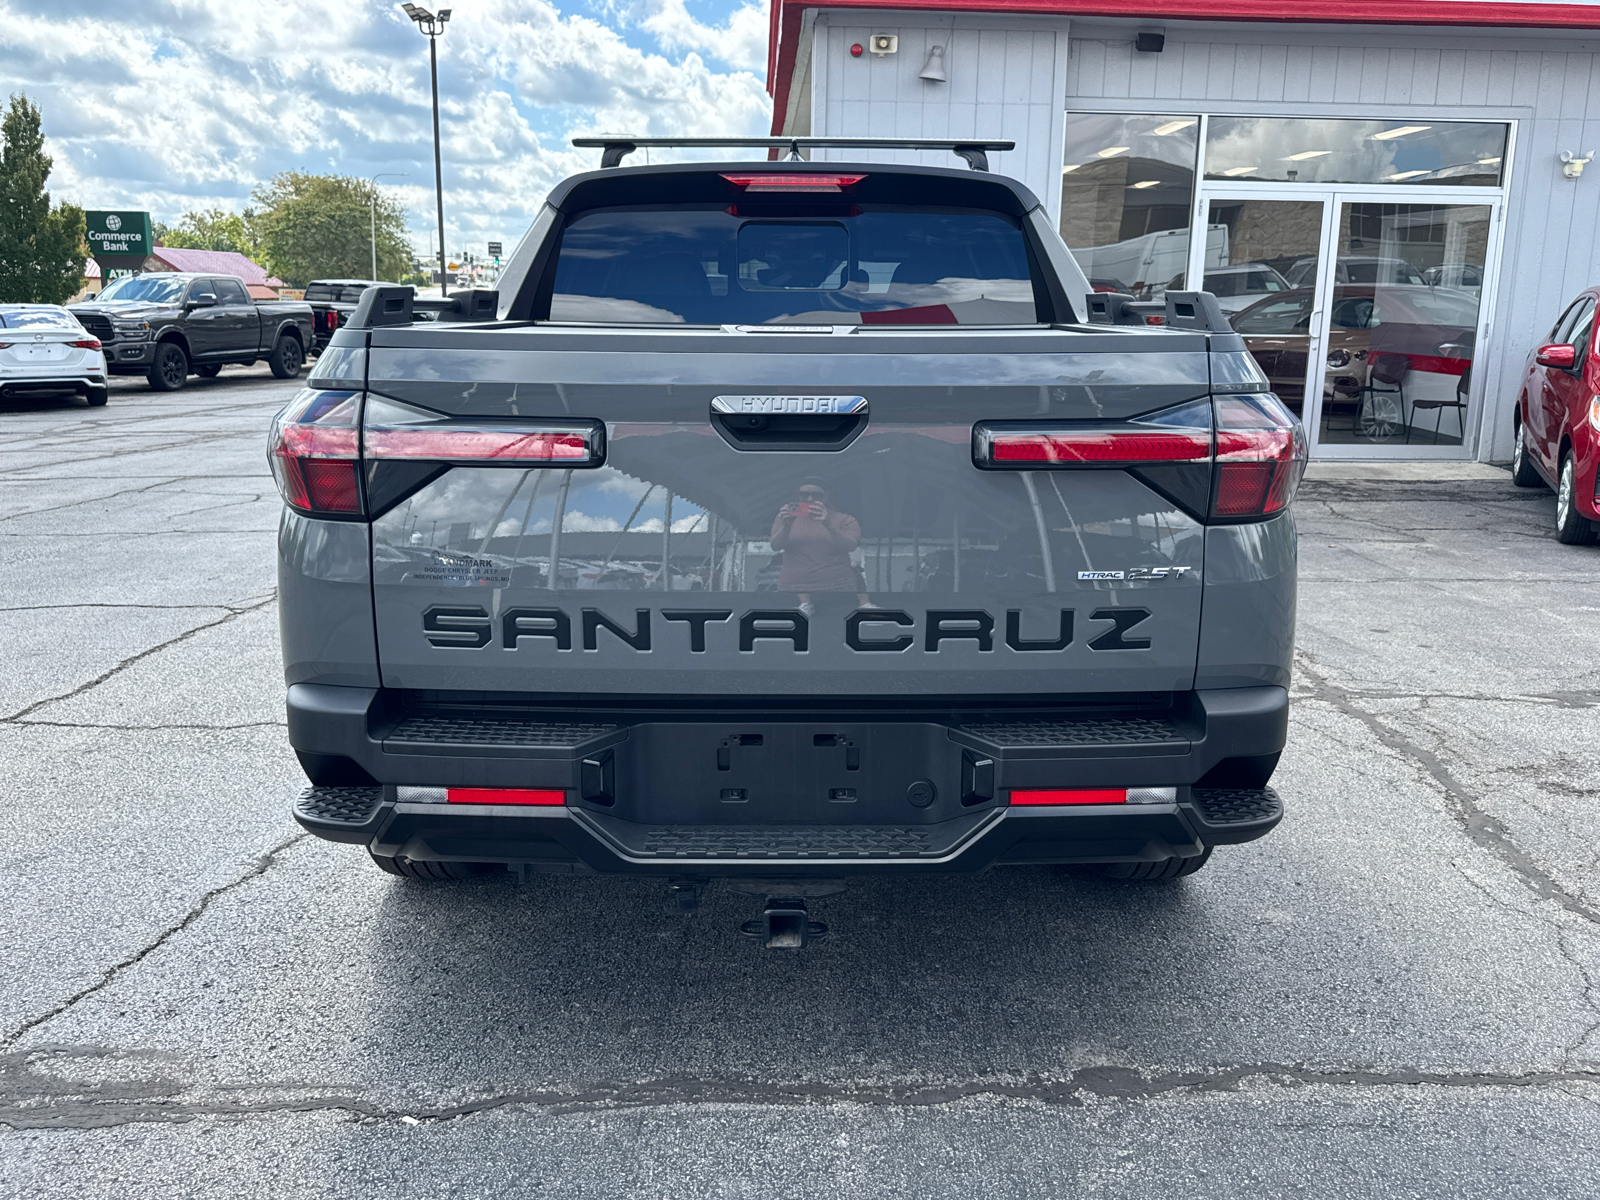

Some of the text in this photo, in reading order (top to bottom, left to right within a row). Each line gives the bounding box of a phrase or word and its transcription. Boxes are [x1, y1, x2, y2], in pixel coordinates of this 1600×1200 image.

[88, 230, 142, 242] Commerce
[103, 241, 129, 251] Bank
[741, 398, 838, 412] HYUNDAI
[422, 604, 1154, 654] SANTA CRUZ
